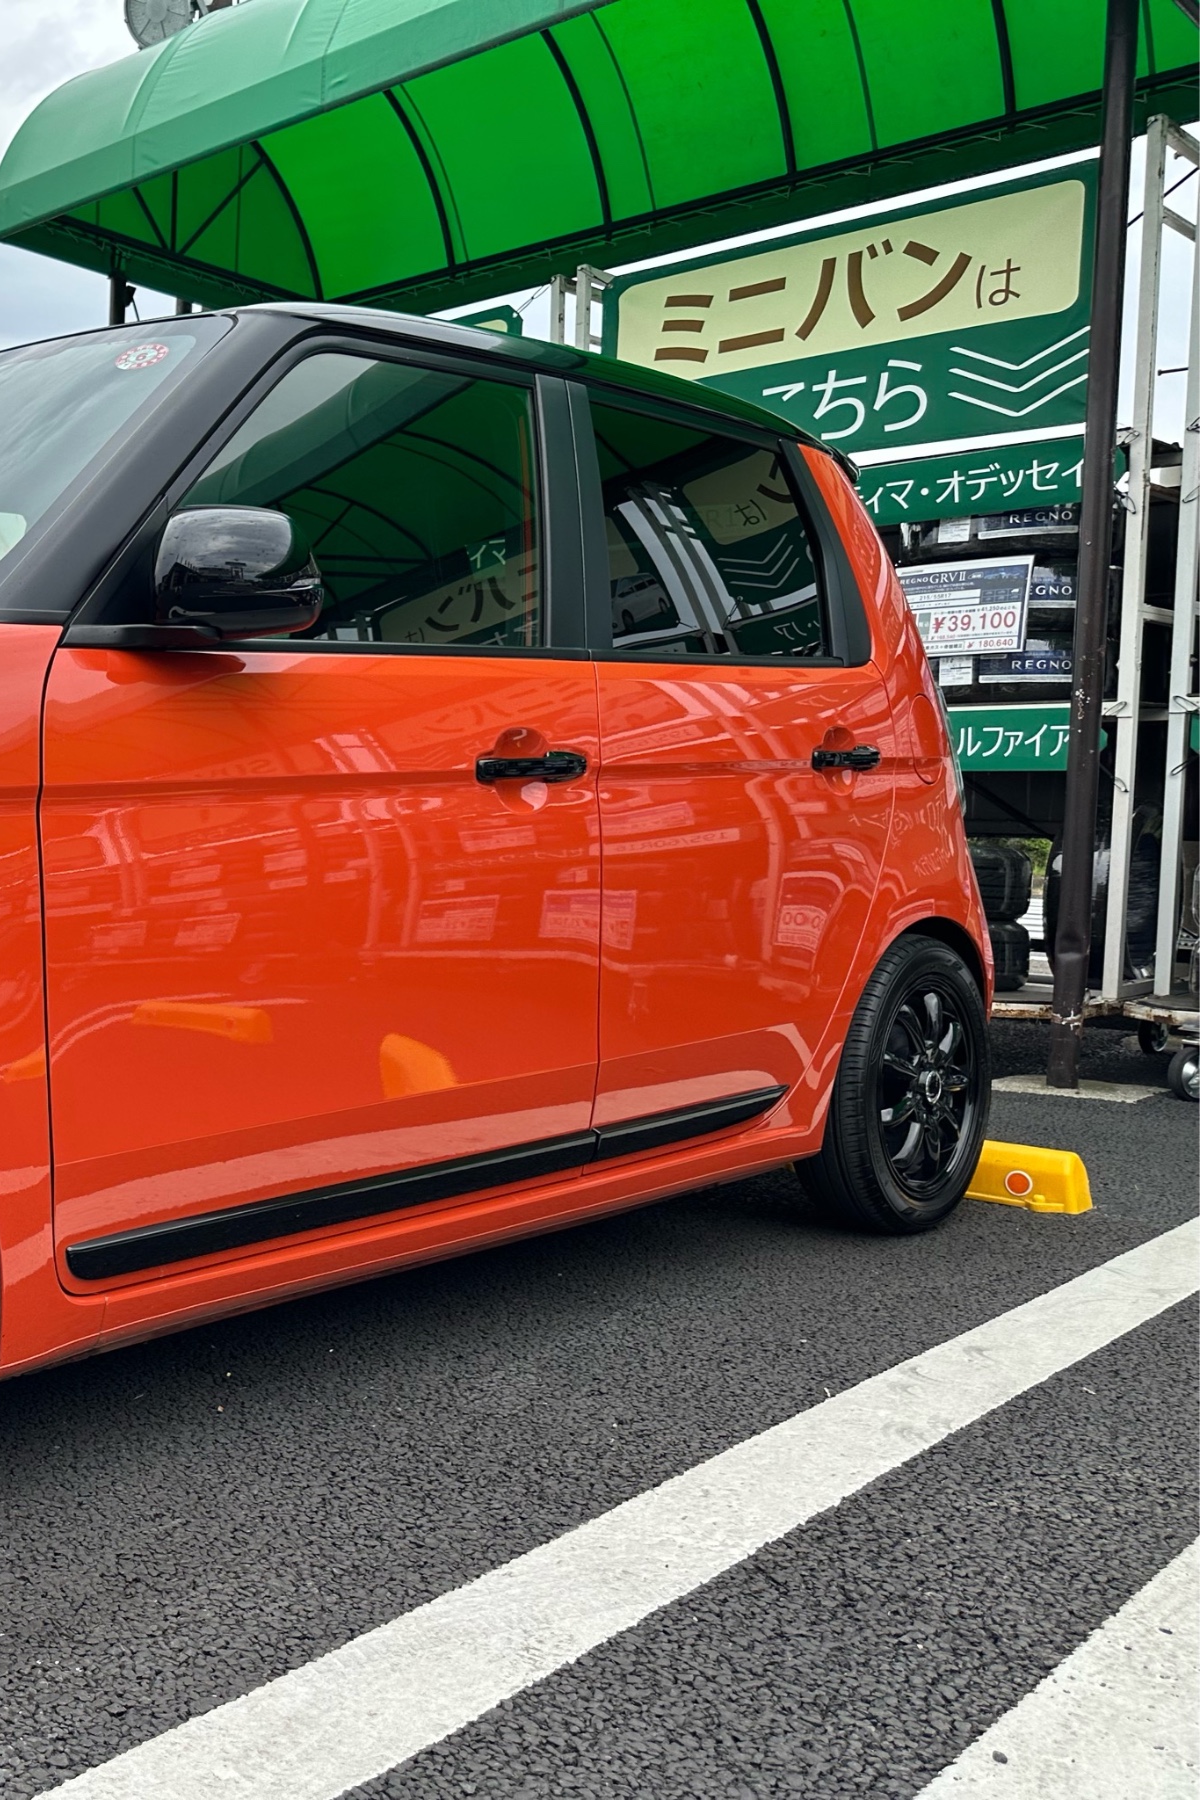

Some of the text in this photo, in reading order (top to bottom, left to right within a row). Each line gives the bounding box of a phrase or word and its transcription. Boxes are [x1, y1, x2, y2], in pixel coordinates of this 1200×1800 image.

[653, 239, 1022, 364] ミニバンは
[1009, 510, 1073, 524] REGNO
[932, 611, 1017, 634] ¥39,100
[1011, 659, 1072, 670] REGNO
